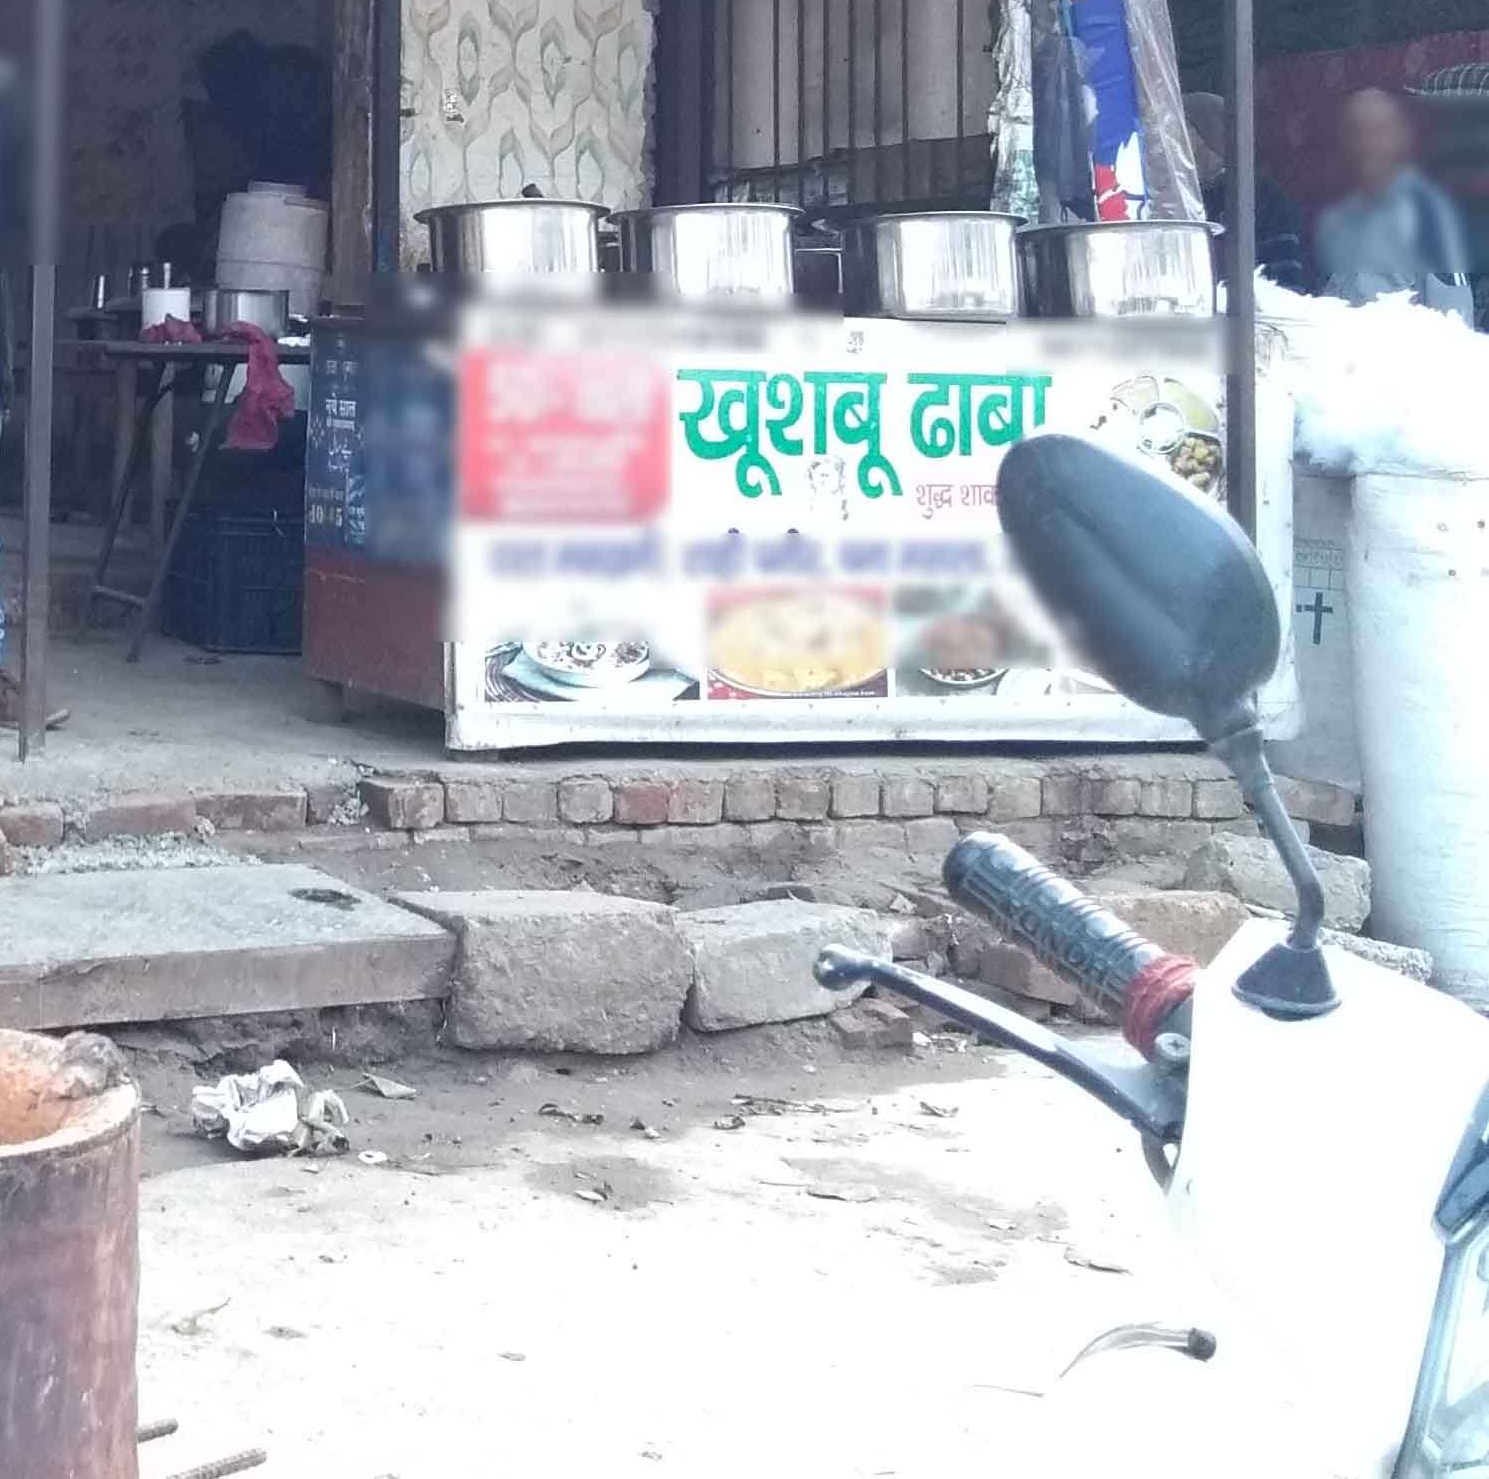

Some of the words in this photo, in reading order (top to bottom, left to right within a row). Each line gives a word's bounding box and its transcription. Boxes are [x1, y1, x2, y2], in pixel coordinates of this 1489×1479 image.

[676, 369, 903, 498] खूशबू
[907, 372, 1052, 458] ढाबा
[916, 483, 954, 519] शुद्ध
